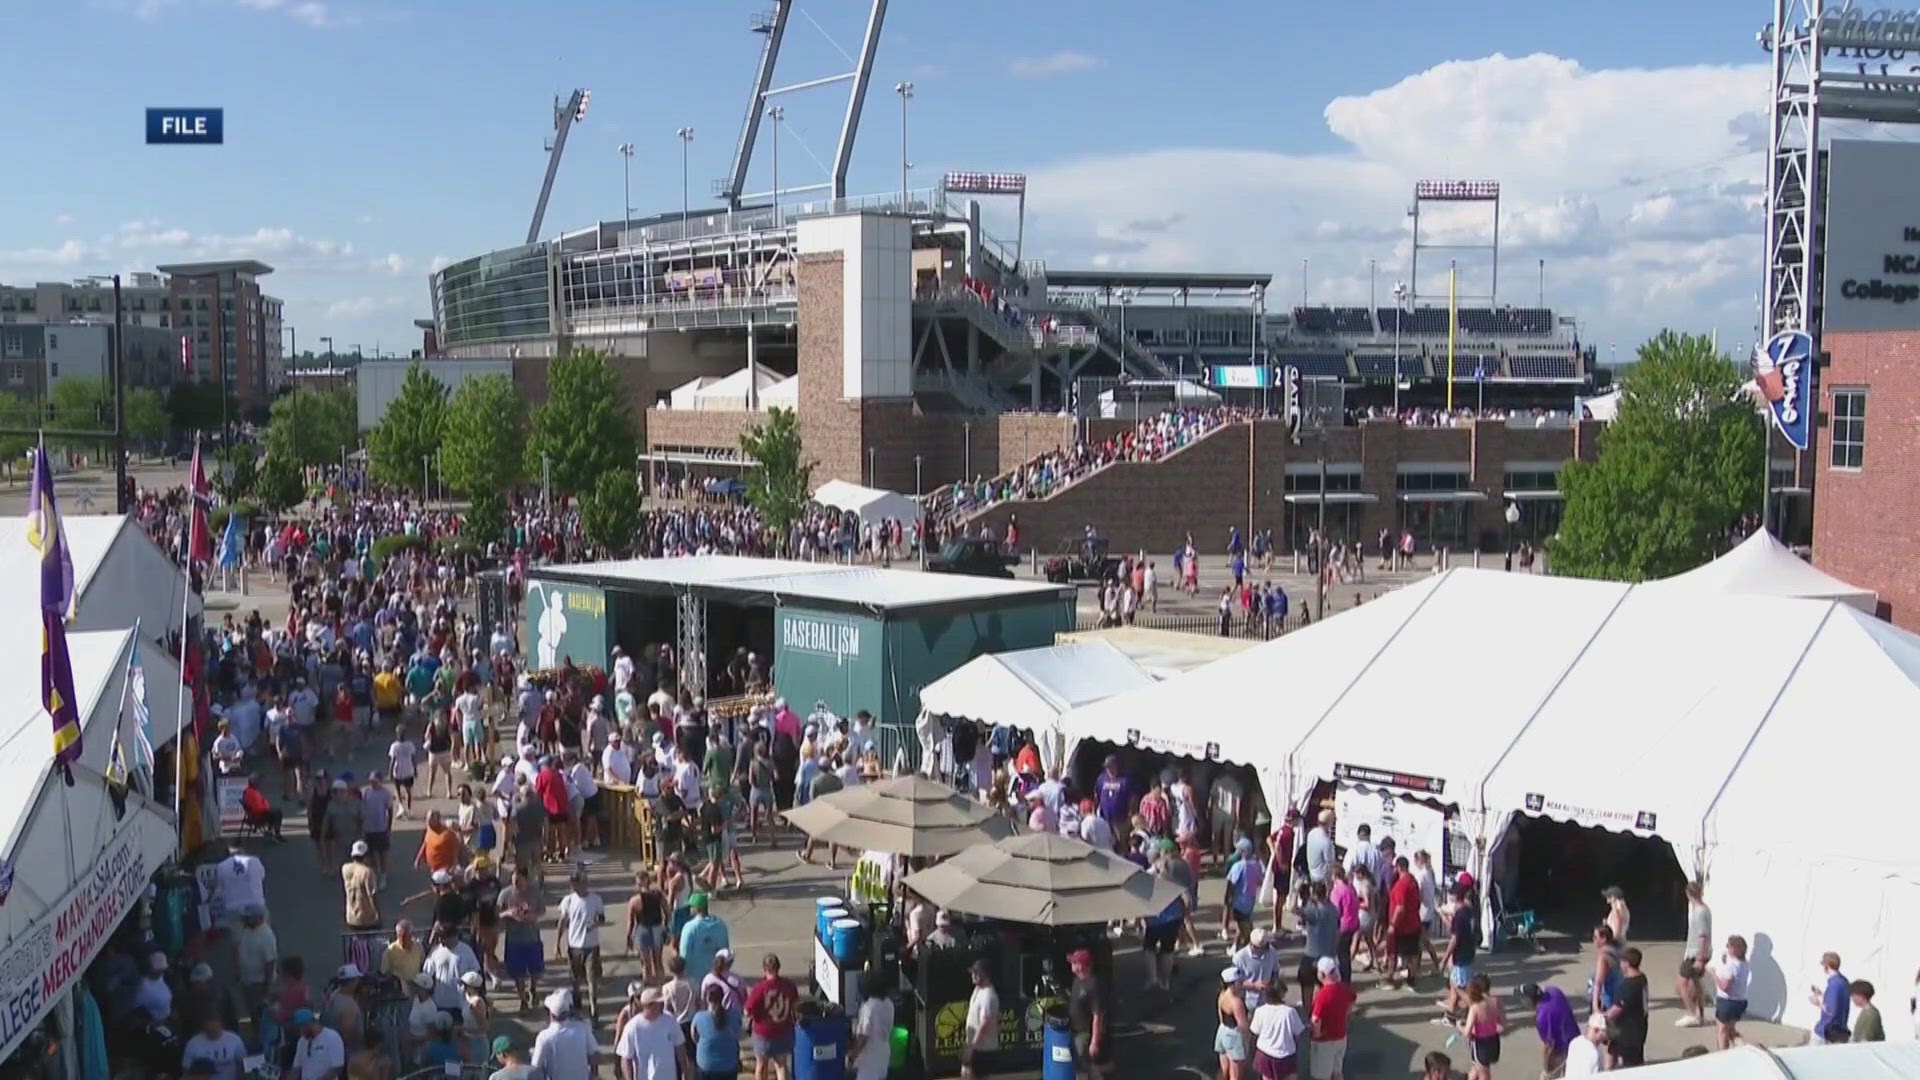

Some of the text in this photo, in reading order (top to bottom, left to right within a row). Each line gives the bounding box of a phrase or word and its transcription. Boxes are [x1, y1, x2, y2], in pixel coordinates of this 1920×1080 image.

[783, 618, 860, 667] BASEBALLISM
[42, 889, 119, 1001] MERCHANDISE
[117, 853, 147, 910] STORE
